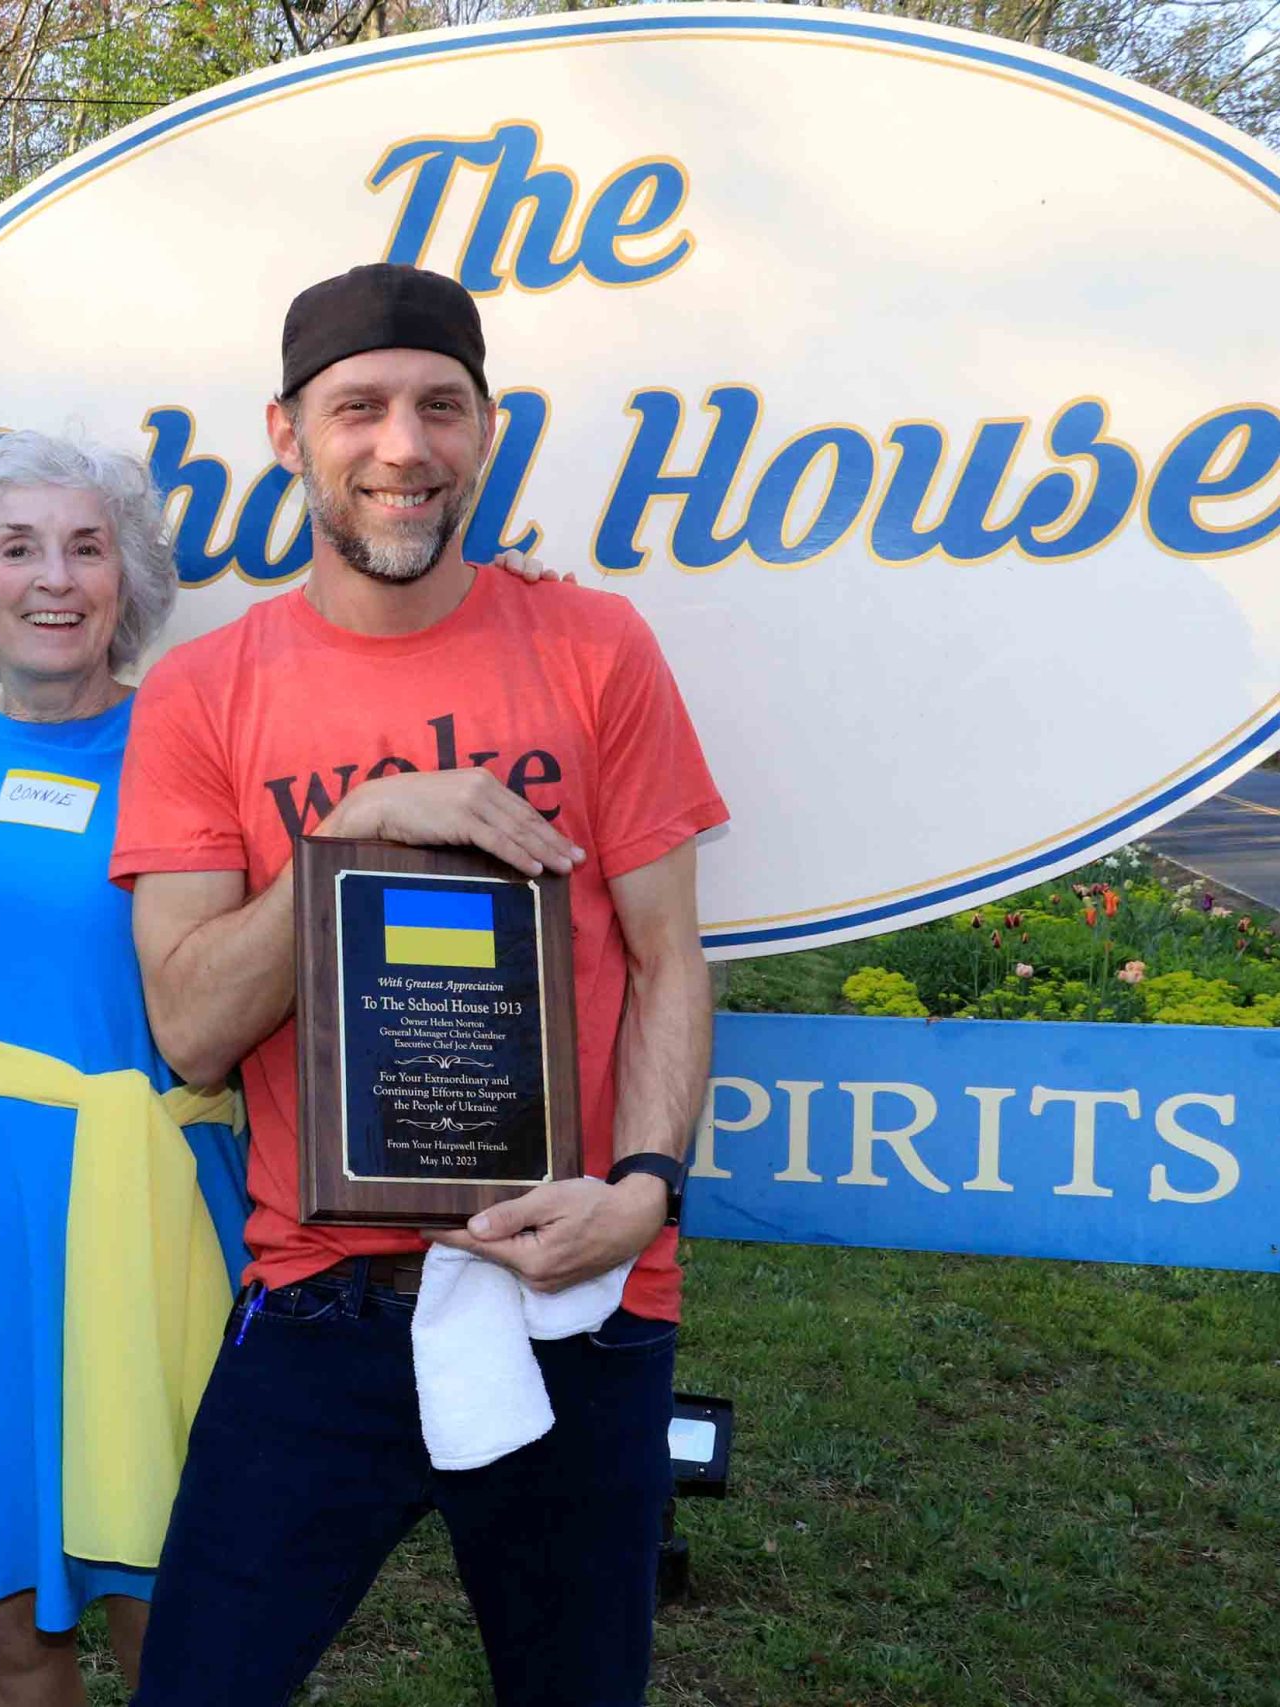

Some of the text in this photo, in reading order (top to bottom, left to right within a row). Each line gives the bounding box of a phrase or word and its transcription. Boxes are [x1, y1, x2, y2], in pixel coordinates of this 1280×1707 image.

[363, 118, 695, 297] The
[591, 382, 1280, 571] House
[9, 783, 77, 806] CONNIE
[378, 977, 504, 993] With Greatest Appreciation
[361, 996, 522, 1015] To The School House 1913
[400, 1016, 485, 1028] Owner Helen Norton
[379, 1027, 507, 1040] General Manager Chris Gardner
[394, 1039, 493, 1051] Executive Chef Joe Arena
[380, 1072, 509, 1087] For Your Extraordinary and
[373, 1085, 517, 1101] Continuing Efforts to Support
[394, 1100, 498, 1113] the People of Ukraine
[387, 1139, 508, 1152] From Your Harpswell Friends
[688, 1076, 1241, 1203] PIRITS
[420, 1155, 477, 1167] May 10, 2023
